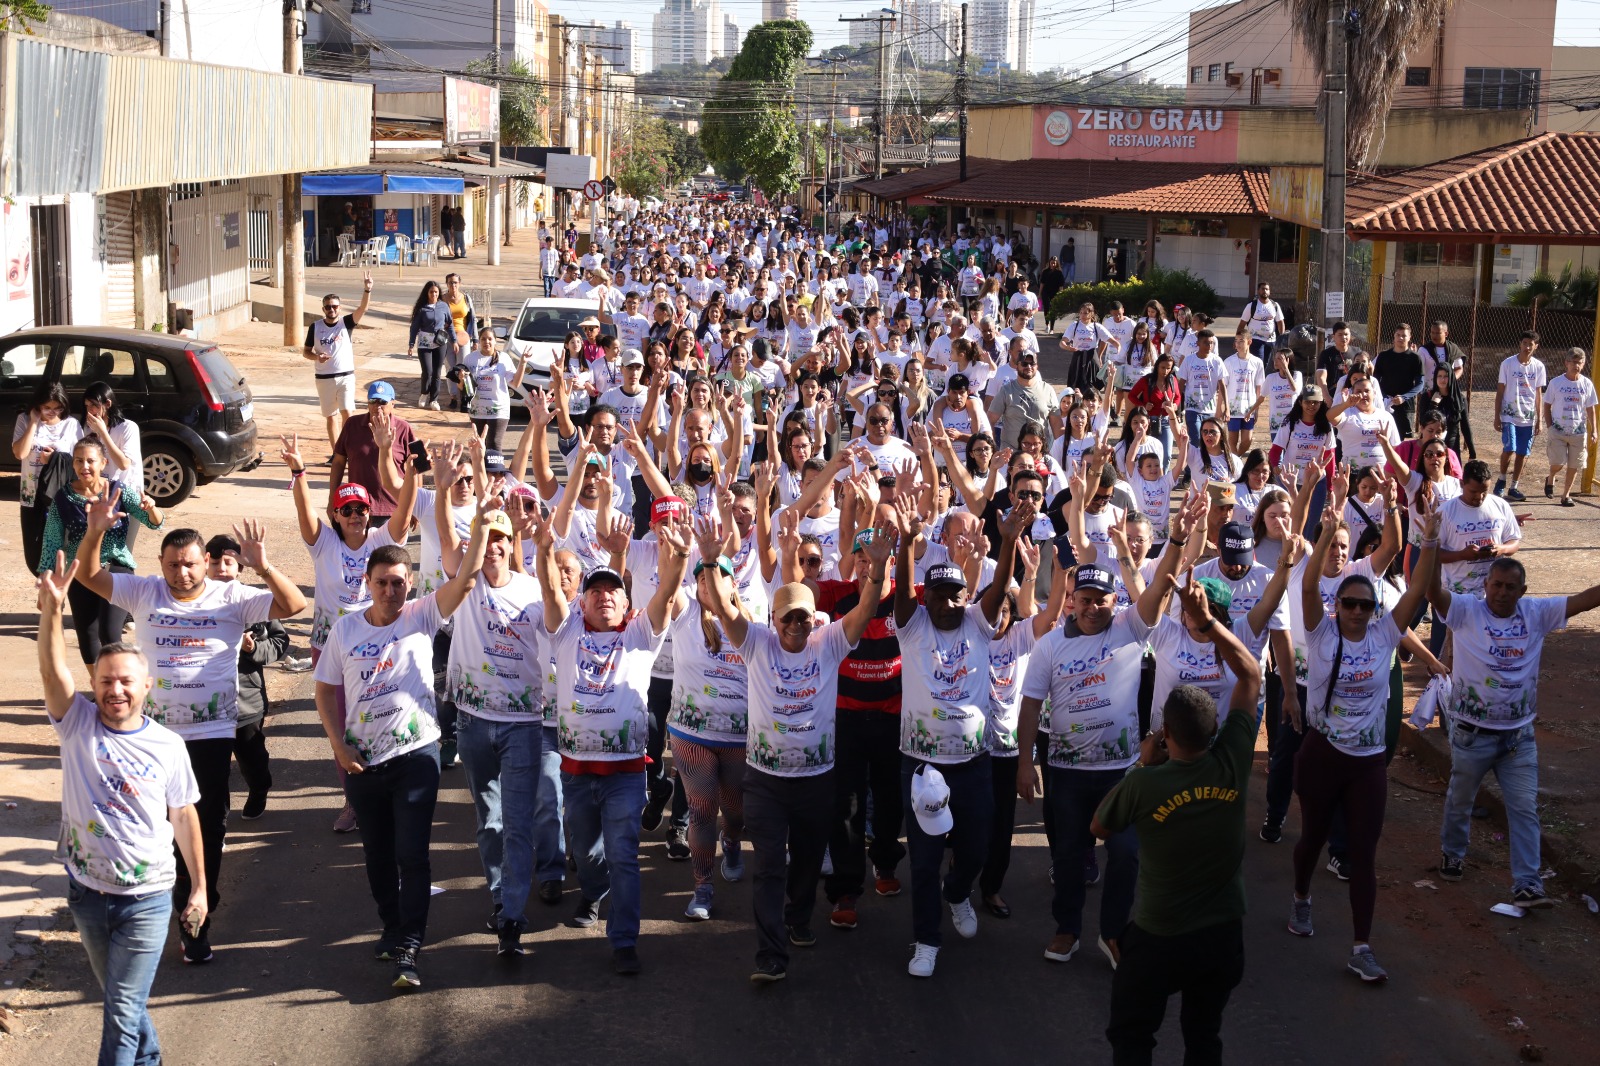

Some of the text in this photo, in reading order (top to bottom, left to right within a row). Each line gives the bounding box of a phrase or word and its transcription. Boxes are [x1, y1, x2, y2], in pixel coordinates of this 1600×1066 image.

[1077, 108, 1144, 131] ZERO
[1149, 108, 1224, 132] GRAU
[1108, 134, 1196, 149] RESTAURANTE
[155, 636, 206, 647] UNIFAN
[1077, 696, 1099, 705] BAZAR
[373, 706, 404, 720] APARECIDA
[1085, 720, 1115, 732] APARECIDA
[1152, 786, 1239, 823] ANJOS VERDES
